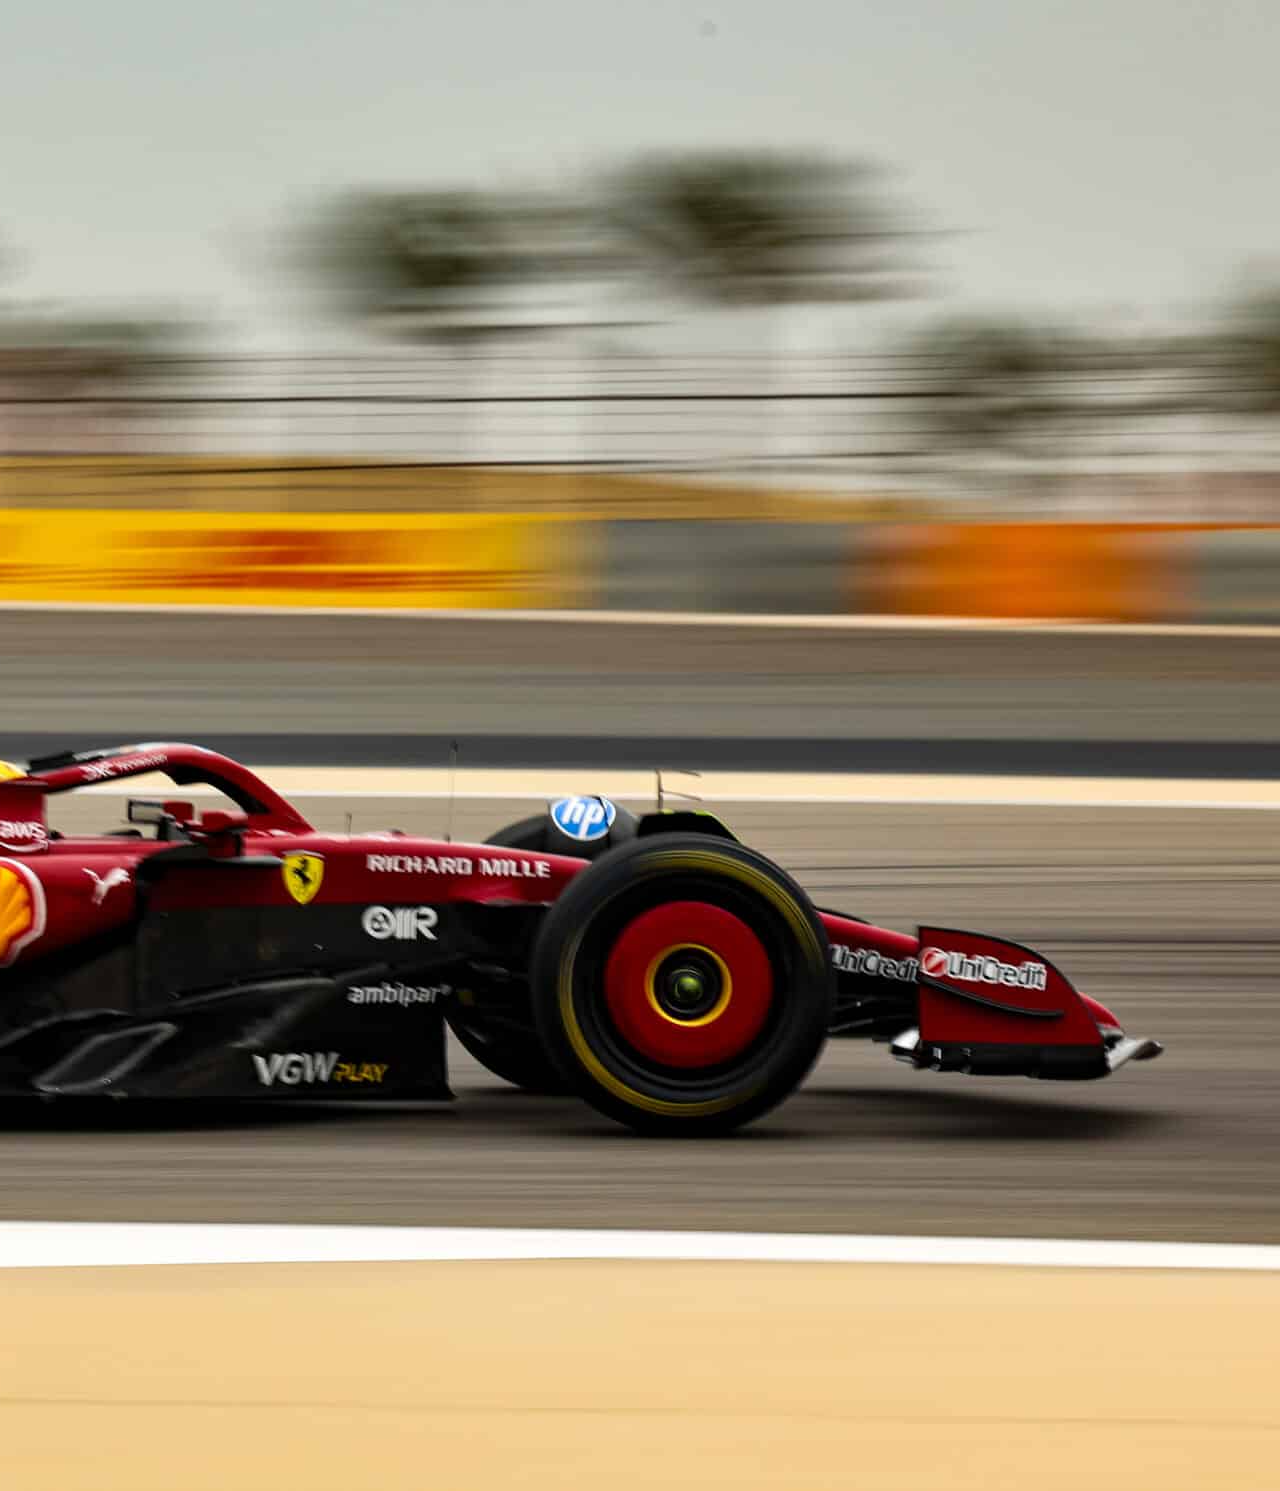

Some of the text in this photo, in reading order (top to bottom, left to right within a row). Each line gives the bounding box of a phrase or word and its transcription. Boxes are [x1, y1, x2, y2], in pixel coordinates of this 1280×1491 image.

[562, 795, 605, 839] hp
[367, 855, 551, 878] RICHARD MILLE
[948, 953, 1048, 990] UniCredit
[348, 983, 438, 1007] ambipar
[253, 1053, 388, 1085] VGW PLAY
